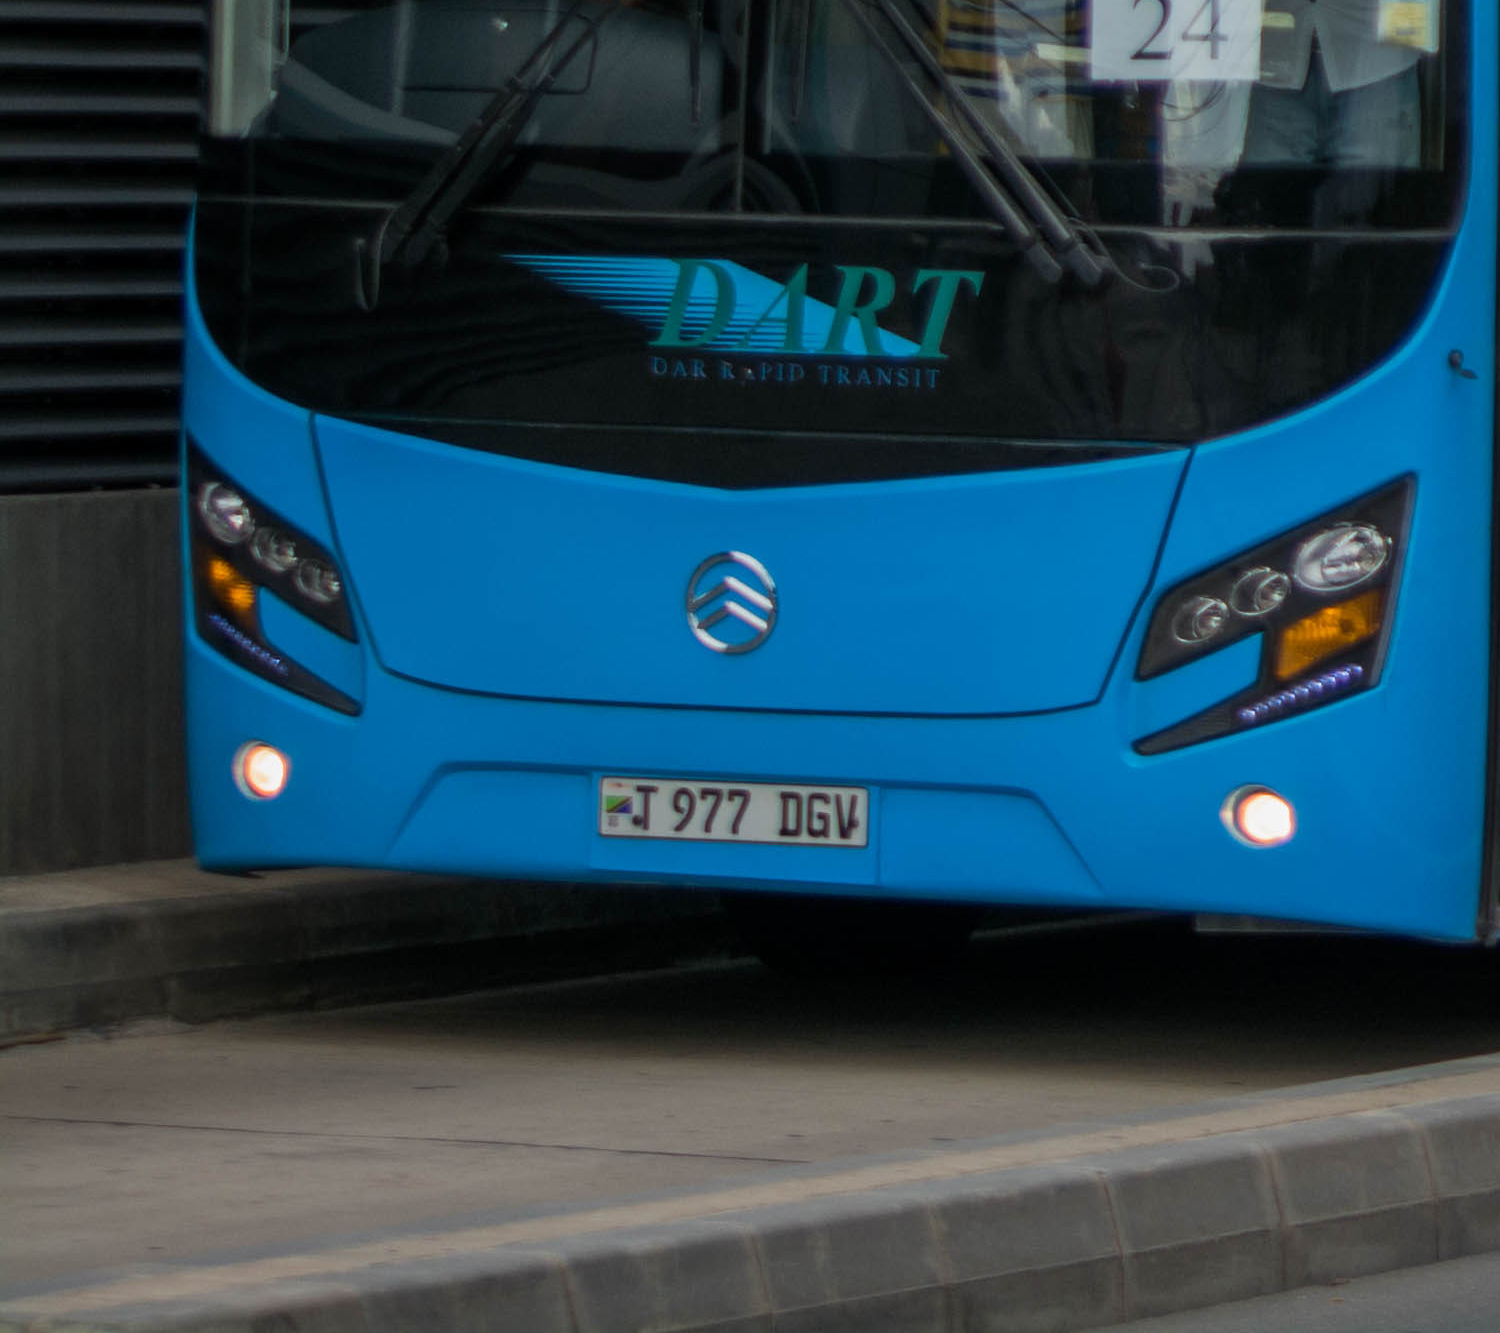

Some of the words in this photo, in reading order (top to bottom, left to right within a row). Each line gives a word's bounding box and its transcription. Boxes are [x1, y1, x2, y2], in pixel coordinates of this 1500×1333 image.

[648, 258, 986, 358] DART
[650, 356, 707, 379] DAR
[818, 364, 941, 390] TRANSIT
[635, 785, 659, 831] T
[671, 786, 752, 835] 977
[778, 790, 859, 840] DGV
